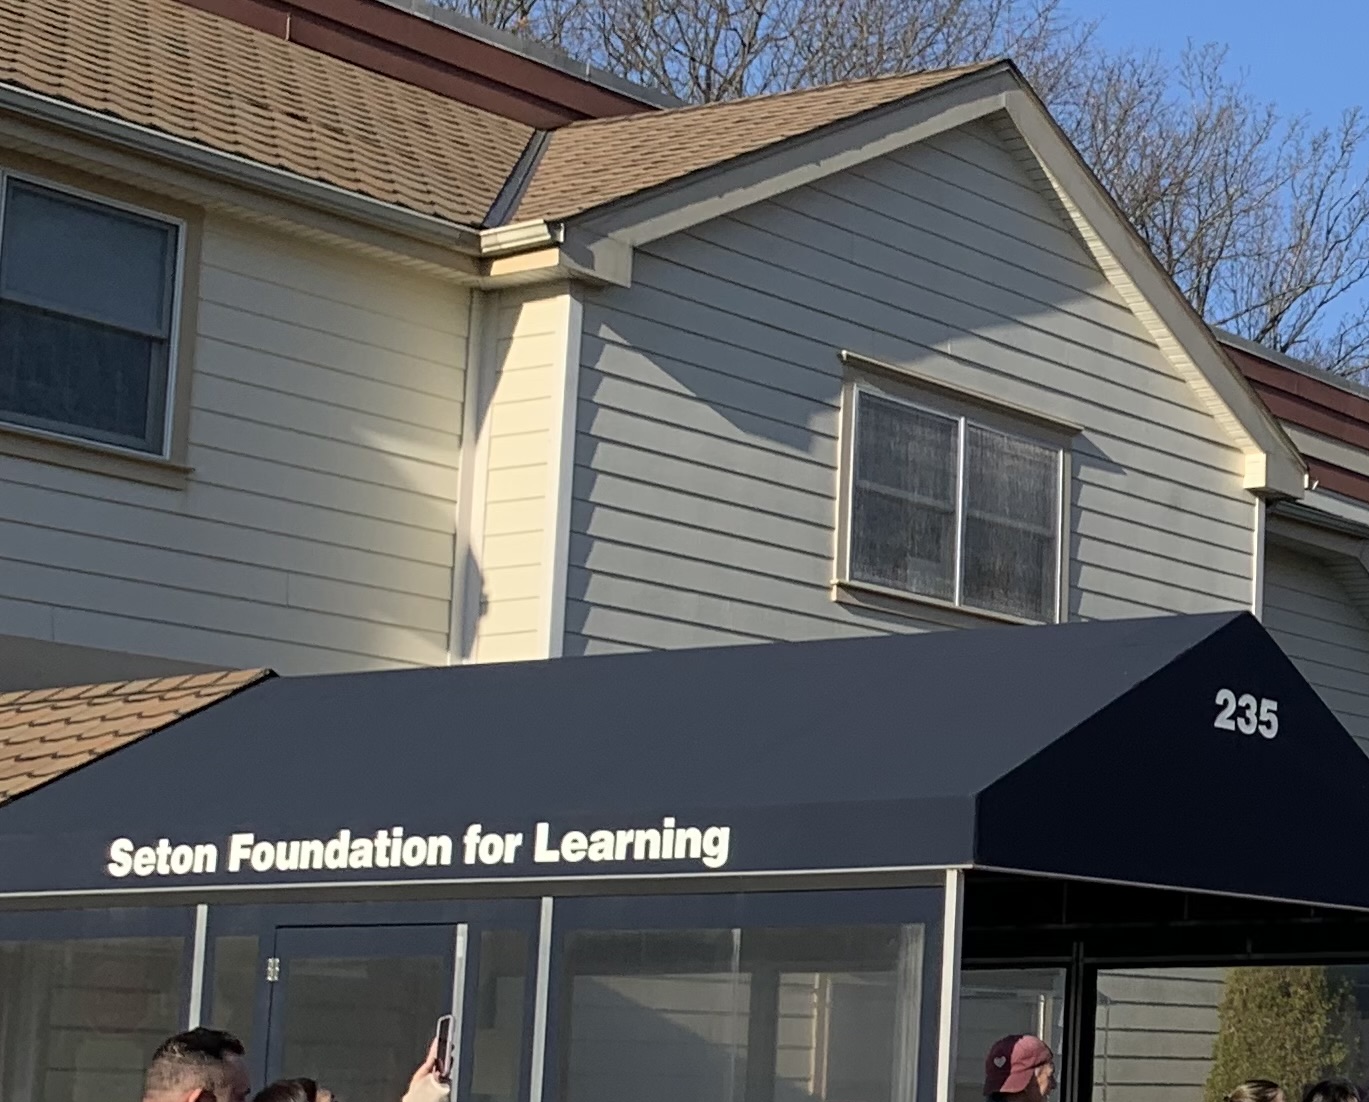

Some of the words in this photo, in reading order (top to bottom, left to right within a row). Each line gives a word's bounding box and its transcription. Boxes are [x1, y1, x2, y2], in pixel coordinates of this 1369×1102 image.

[1213, 688, 1279, 739] 235
[106, 838, 218, 877] Seton
[227, 827, 453, 873] Foundation
[463, 824, 523, 865] for
[534, 817, 731, 868] Learning
